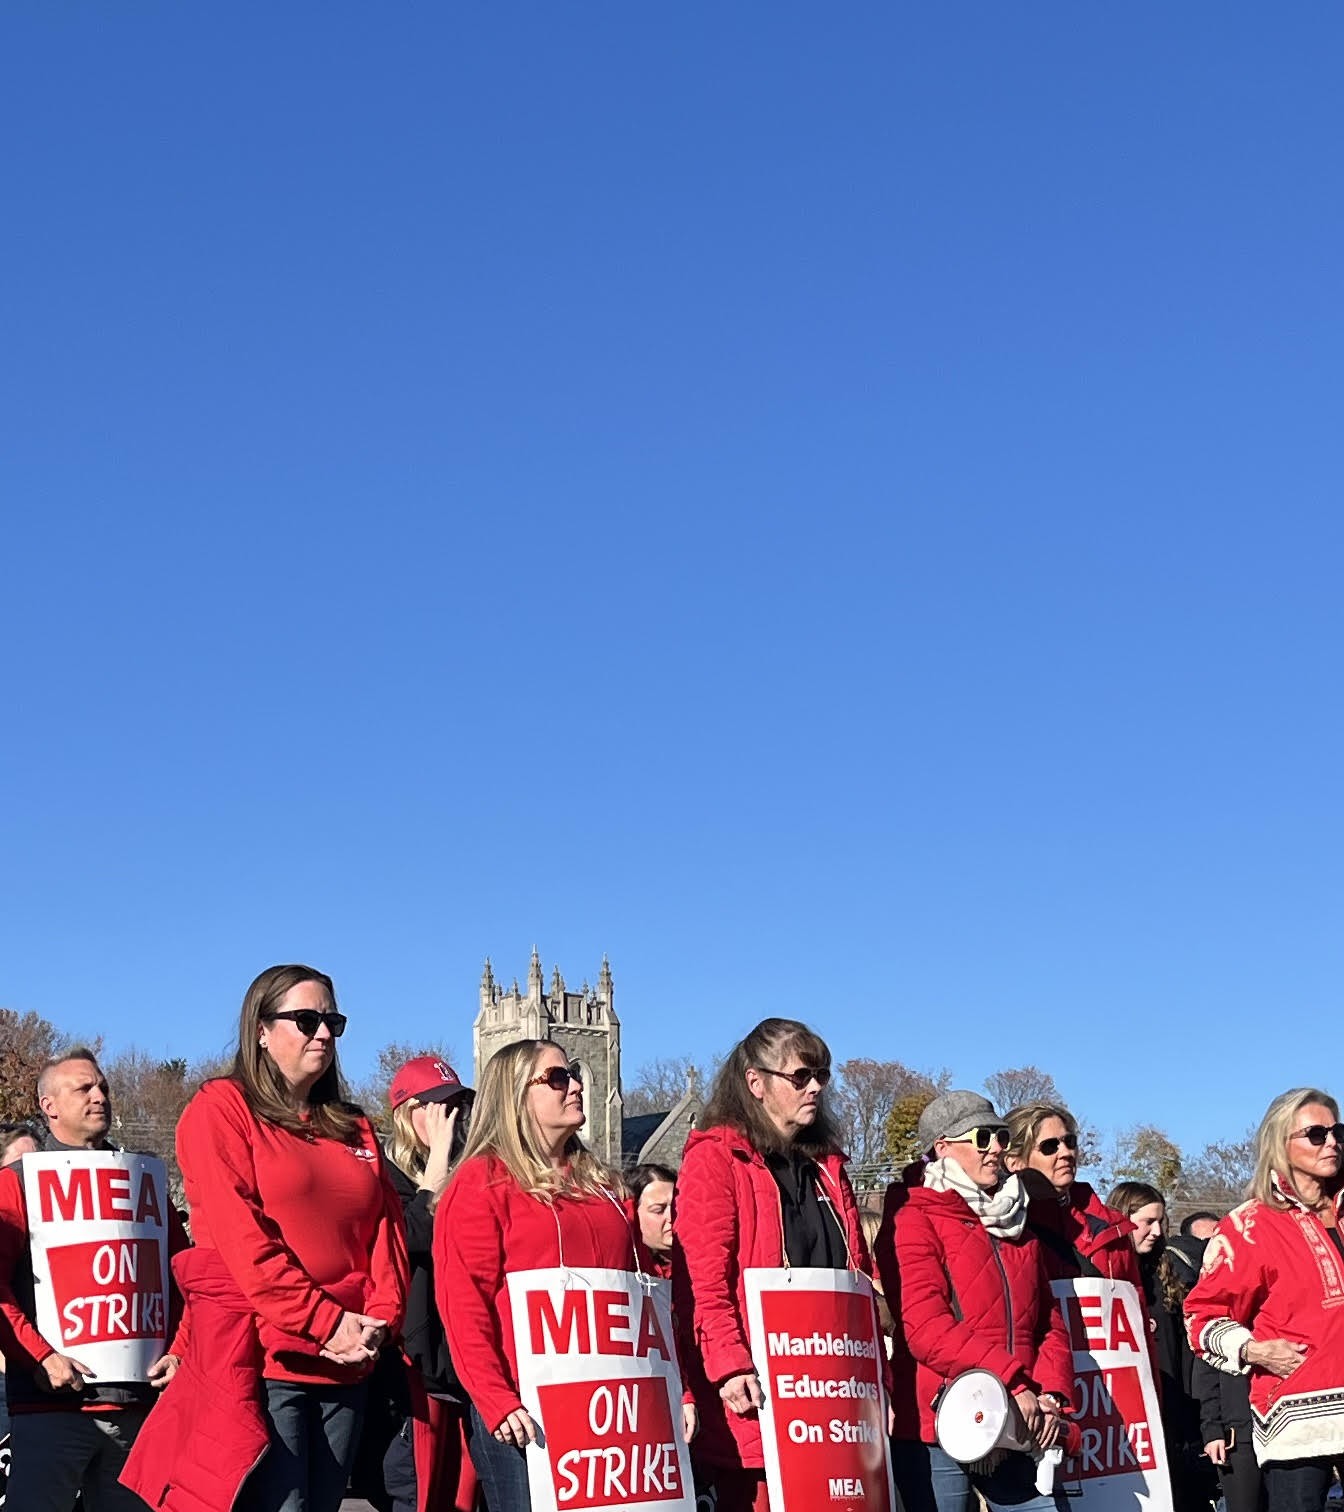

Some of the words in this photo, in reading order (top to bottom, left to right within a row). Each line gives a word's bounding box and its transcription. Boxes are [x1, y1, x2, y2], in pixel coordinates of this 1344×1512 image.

[38, 1168, 162, 1227] MEA
[92, 1243, 138, 1285] ON
[63, 1292, 162, 1340] STRIKE
[526, 1289, 671, 1361] MEA
[1067, 1296, 1140, 1353] EA
[768, 1332, 876, 1359] Marblehead
[588, 1384, 639, 1435] ON
[776, 1374, 878, 1400] Educators
[788, 1419, 823, 1443] On
[557, 1443, 678, 1501] STRIKE
[829, 1479, 864, 1497] MEA
